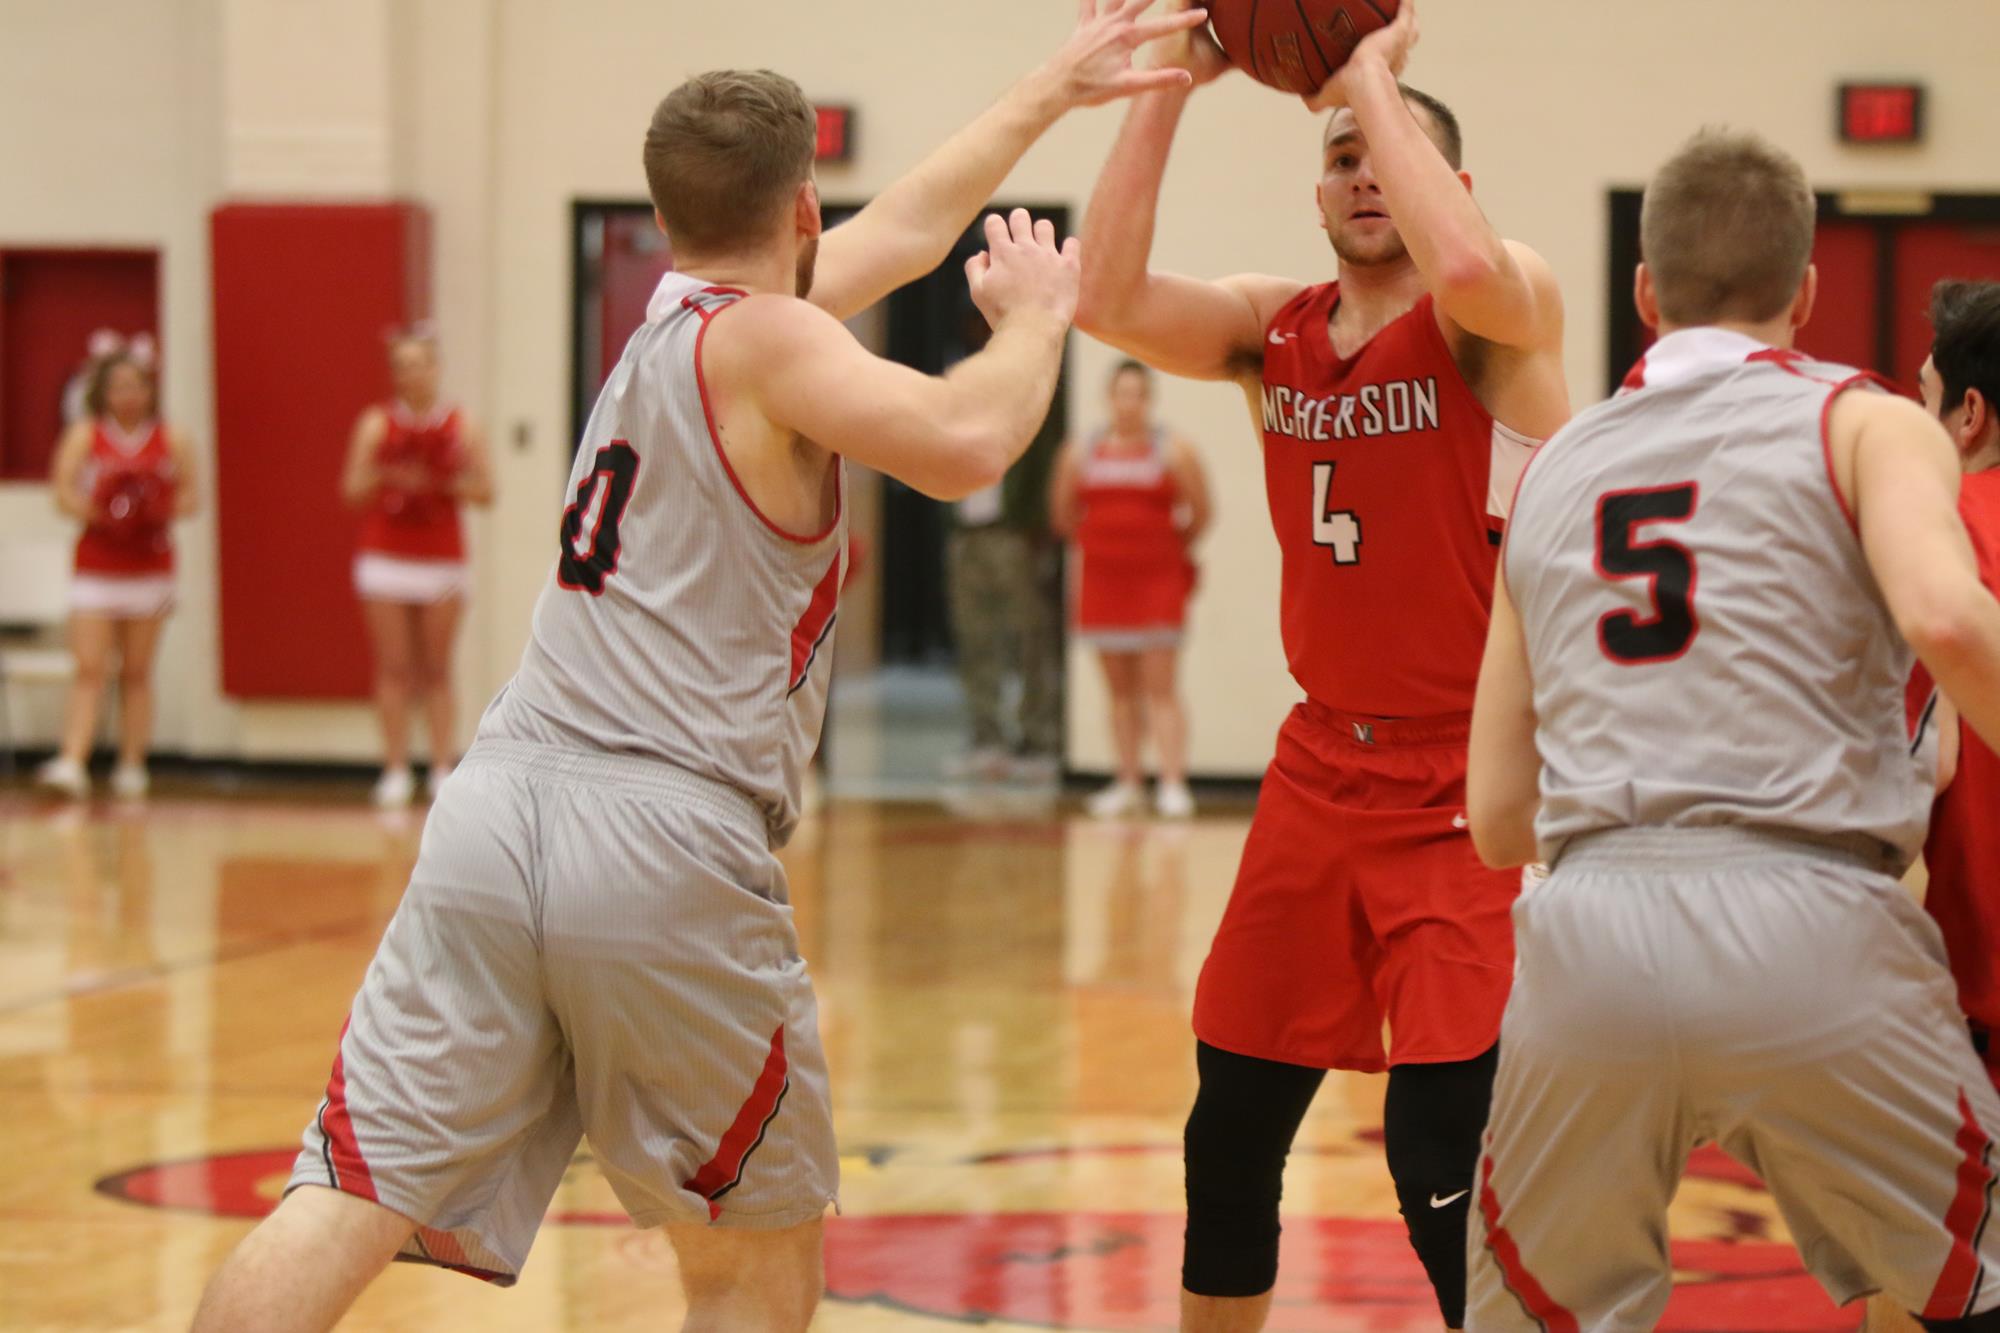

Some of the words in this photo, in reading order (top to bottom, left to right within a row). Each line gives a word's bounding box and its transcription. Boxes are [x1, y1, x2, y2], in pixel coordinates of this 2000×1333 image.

[558, 439, 641, 597] 0
[1312, 461, 1362, 565] 4
[1593, 480, 1700, 666] 5
